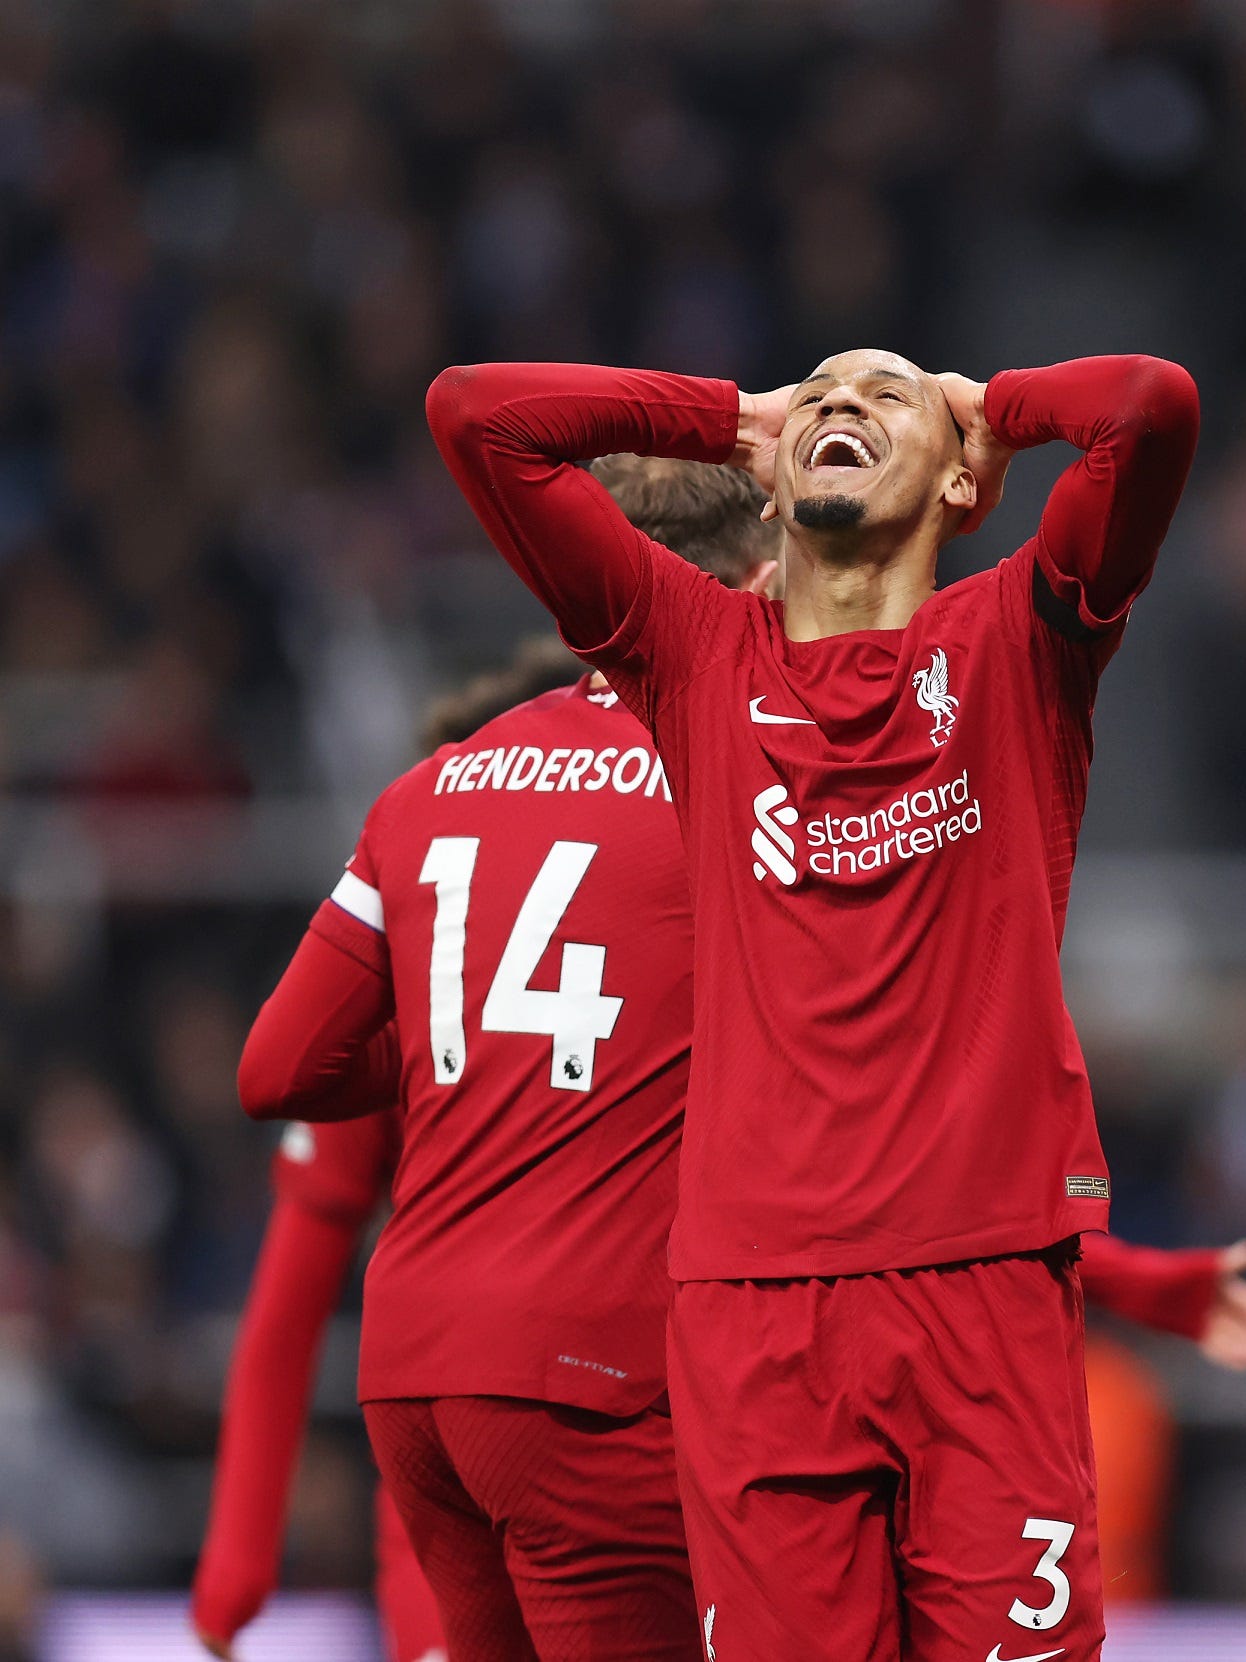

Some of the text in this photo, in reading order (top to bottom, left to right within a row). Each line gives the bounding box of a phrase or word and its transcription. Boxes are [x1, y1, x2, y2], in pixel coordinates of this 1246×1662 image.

[806, 769, 968, 846] standard
[809, 799, 981, 874] chartered
[418, 836, 625, 1091] 14
[1007, 1518, 1075, 1630] 3
